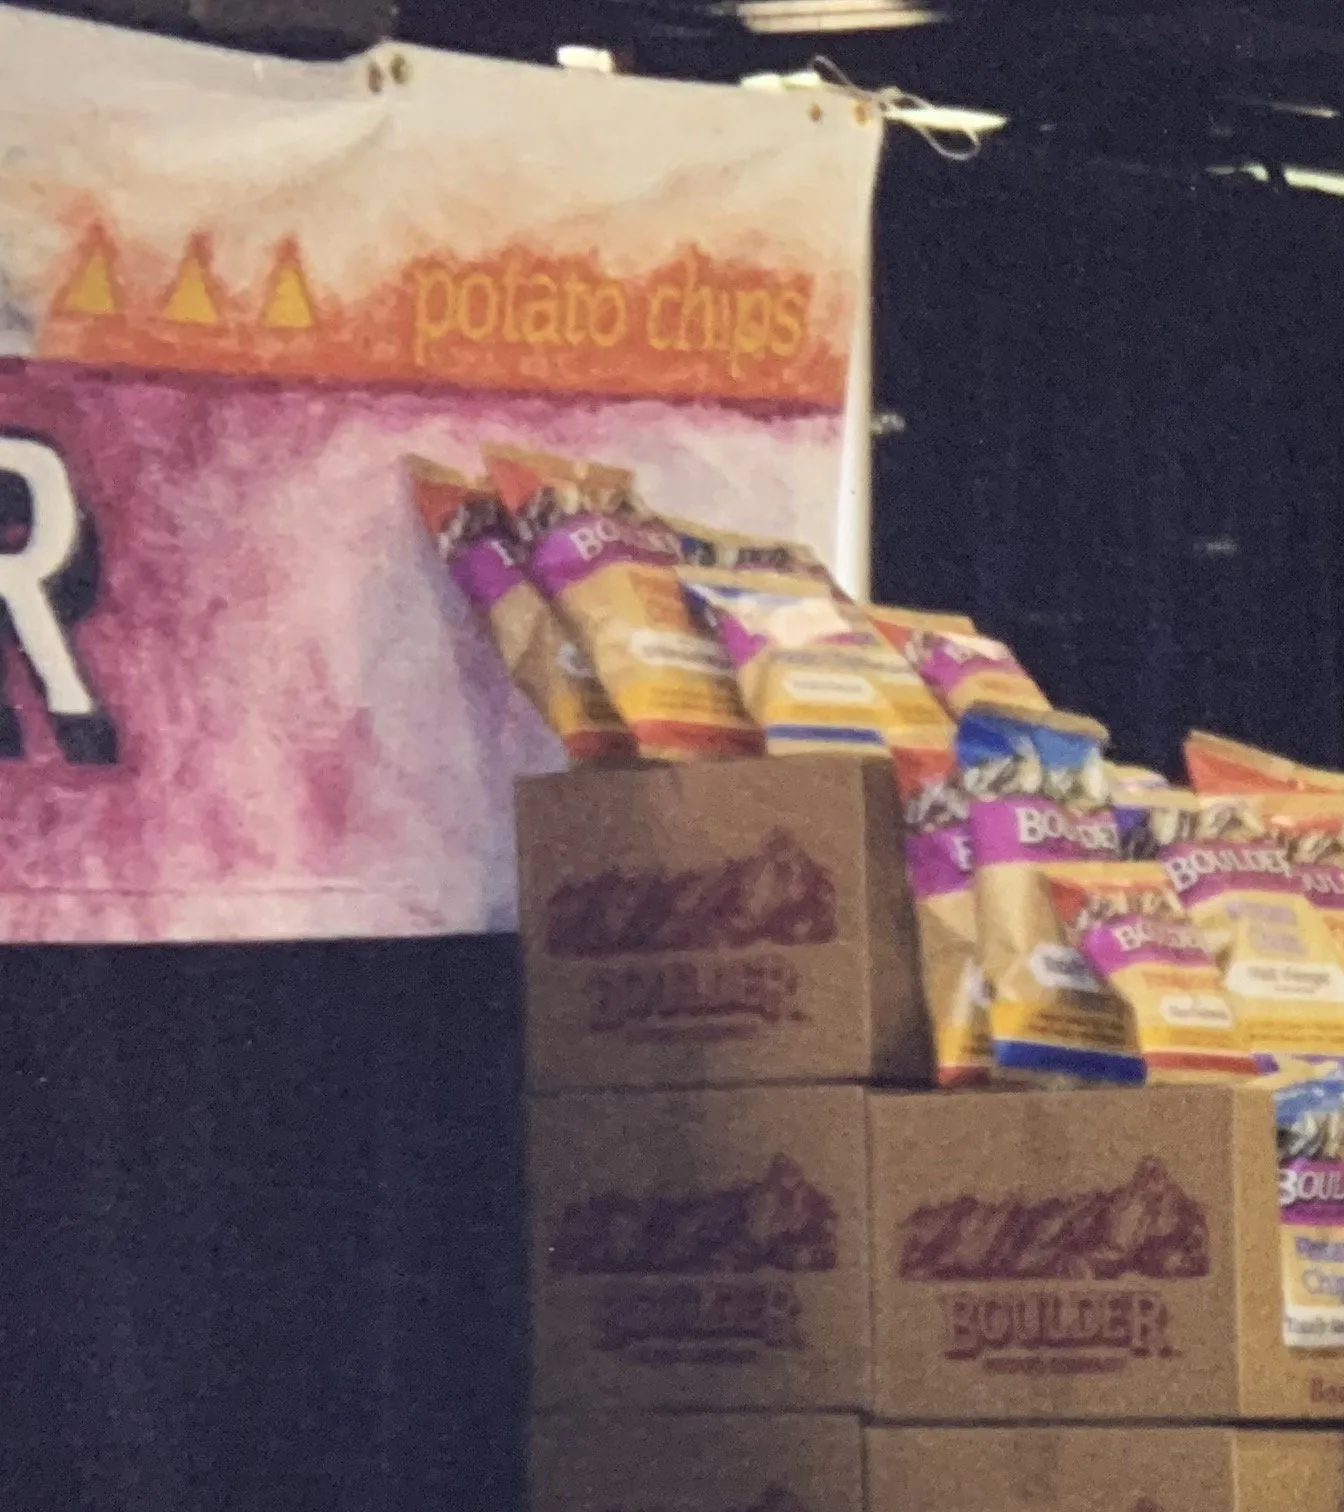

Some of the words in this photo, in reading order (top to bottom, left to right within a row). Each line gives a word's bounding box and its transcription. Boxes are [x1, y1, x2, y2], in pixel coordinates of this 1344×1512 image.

[412, 262, 628, 364] potato
[647, 258, 806, 368] chips
[942, 1291, 1176, 1360] BOULDER
